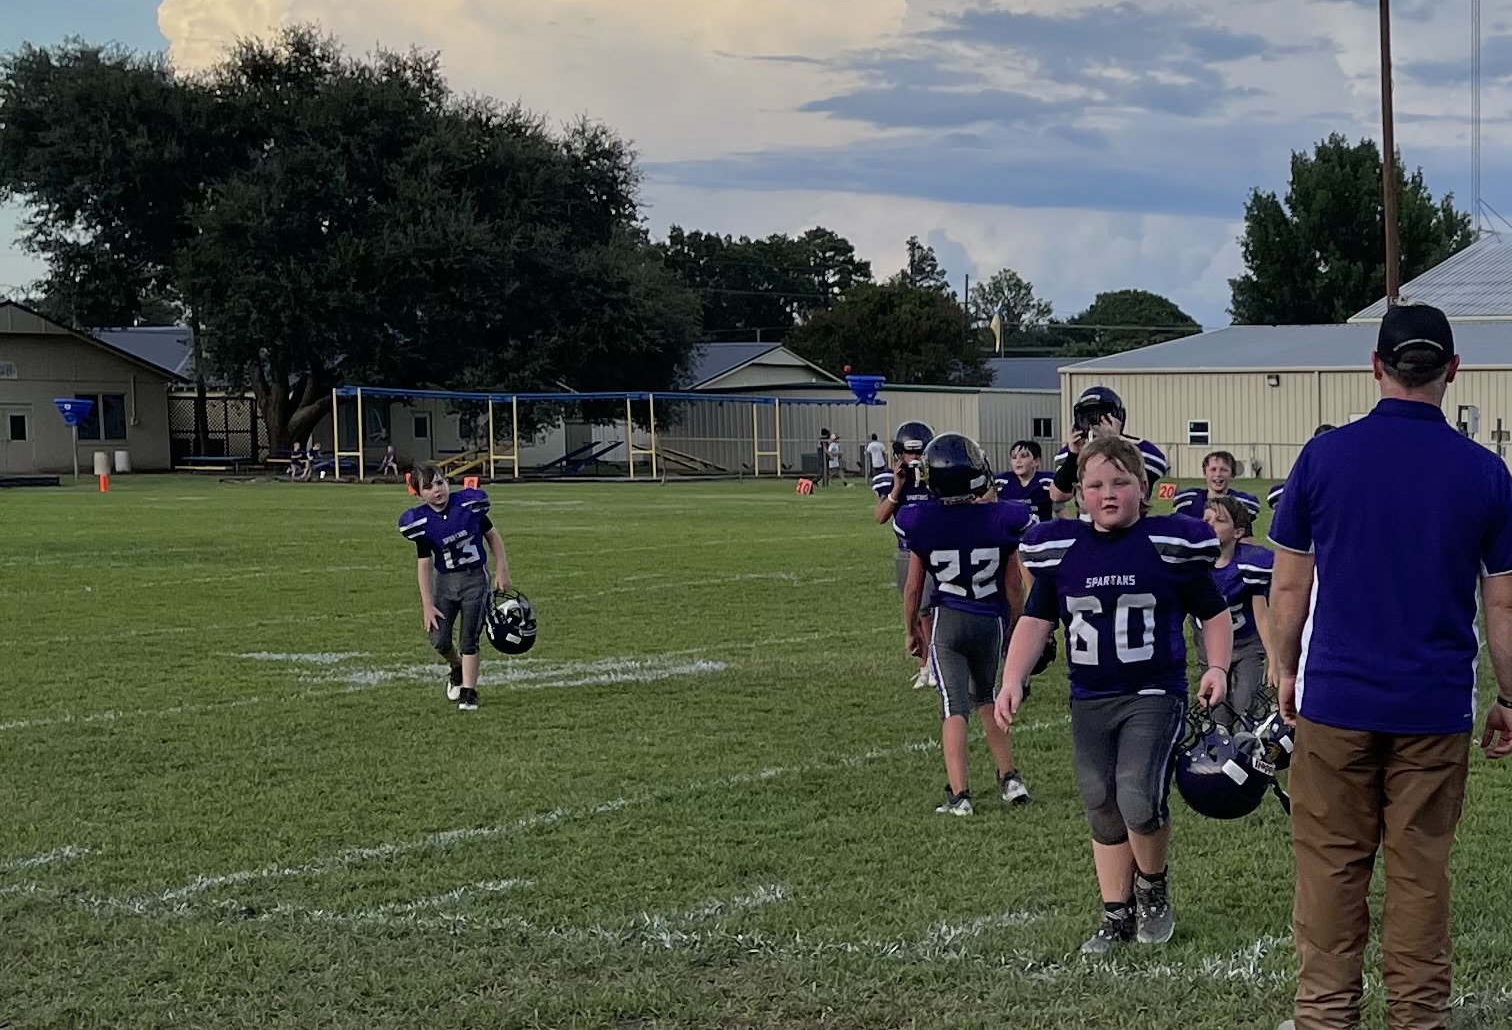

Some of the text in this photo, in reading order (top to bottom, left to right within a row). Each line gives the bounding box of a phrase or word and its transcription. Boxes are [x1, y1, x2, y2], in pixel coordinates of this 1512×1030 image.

[797, 482, 811, 494] 10
[1159, 485, 1174, 498] 20
[443, 535, 481, 569] 13
[930, 547, 1000, 599] 22
[1085, 574, 1136, 588] SPARTANS
[1066, 593, 1156, 665] 60
